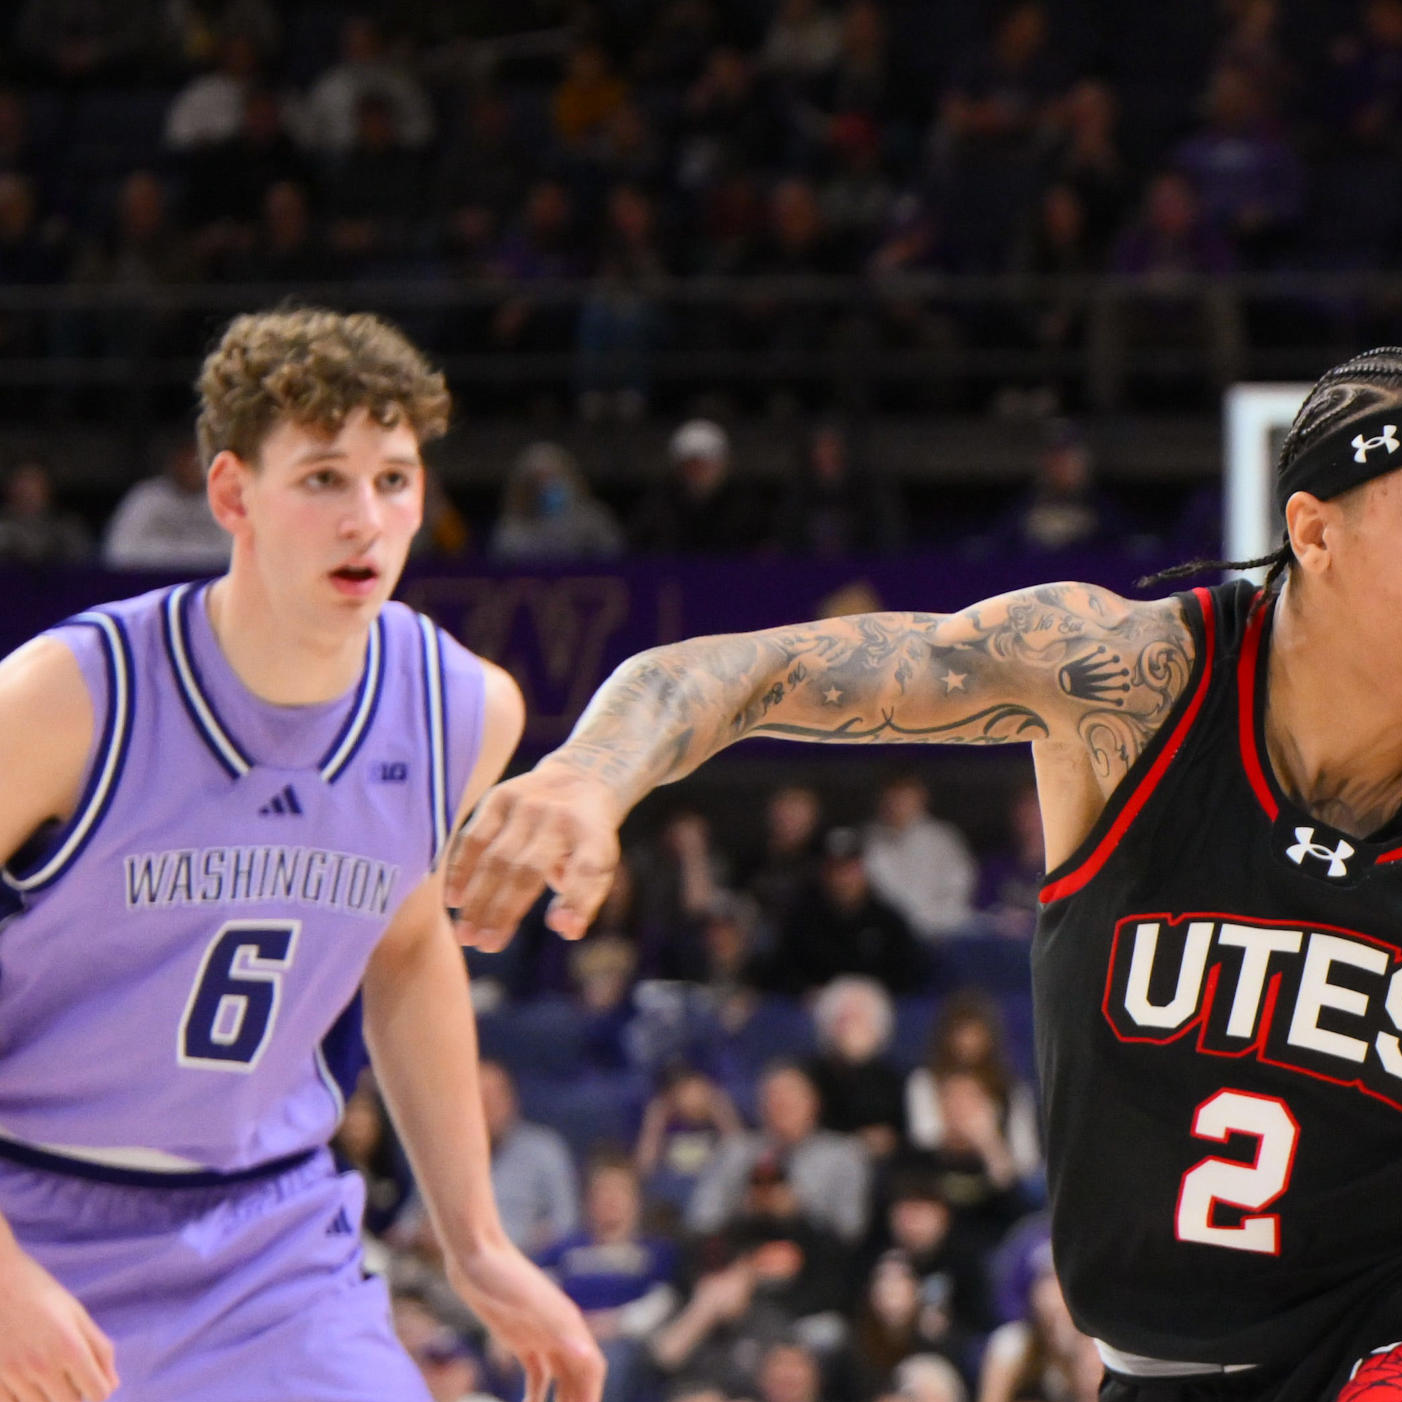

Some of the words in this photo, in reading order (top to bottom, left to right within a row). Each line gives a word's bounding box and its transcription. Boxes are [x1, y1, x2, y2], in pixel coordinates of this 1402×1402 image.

[124, 845, 399, 916] WASHINGTON
[175, 918, 302, 1075] 6
[1174, 1087, 1300, 1256] 2
